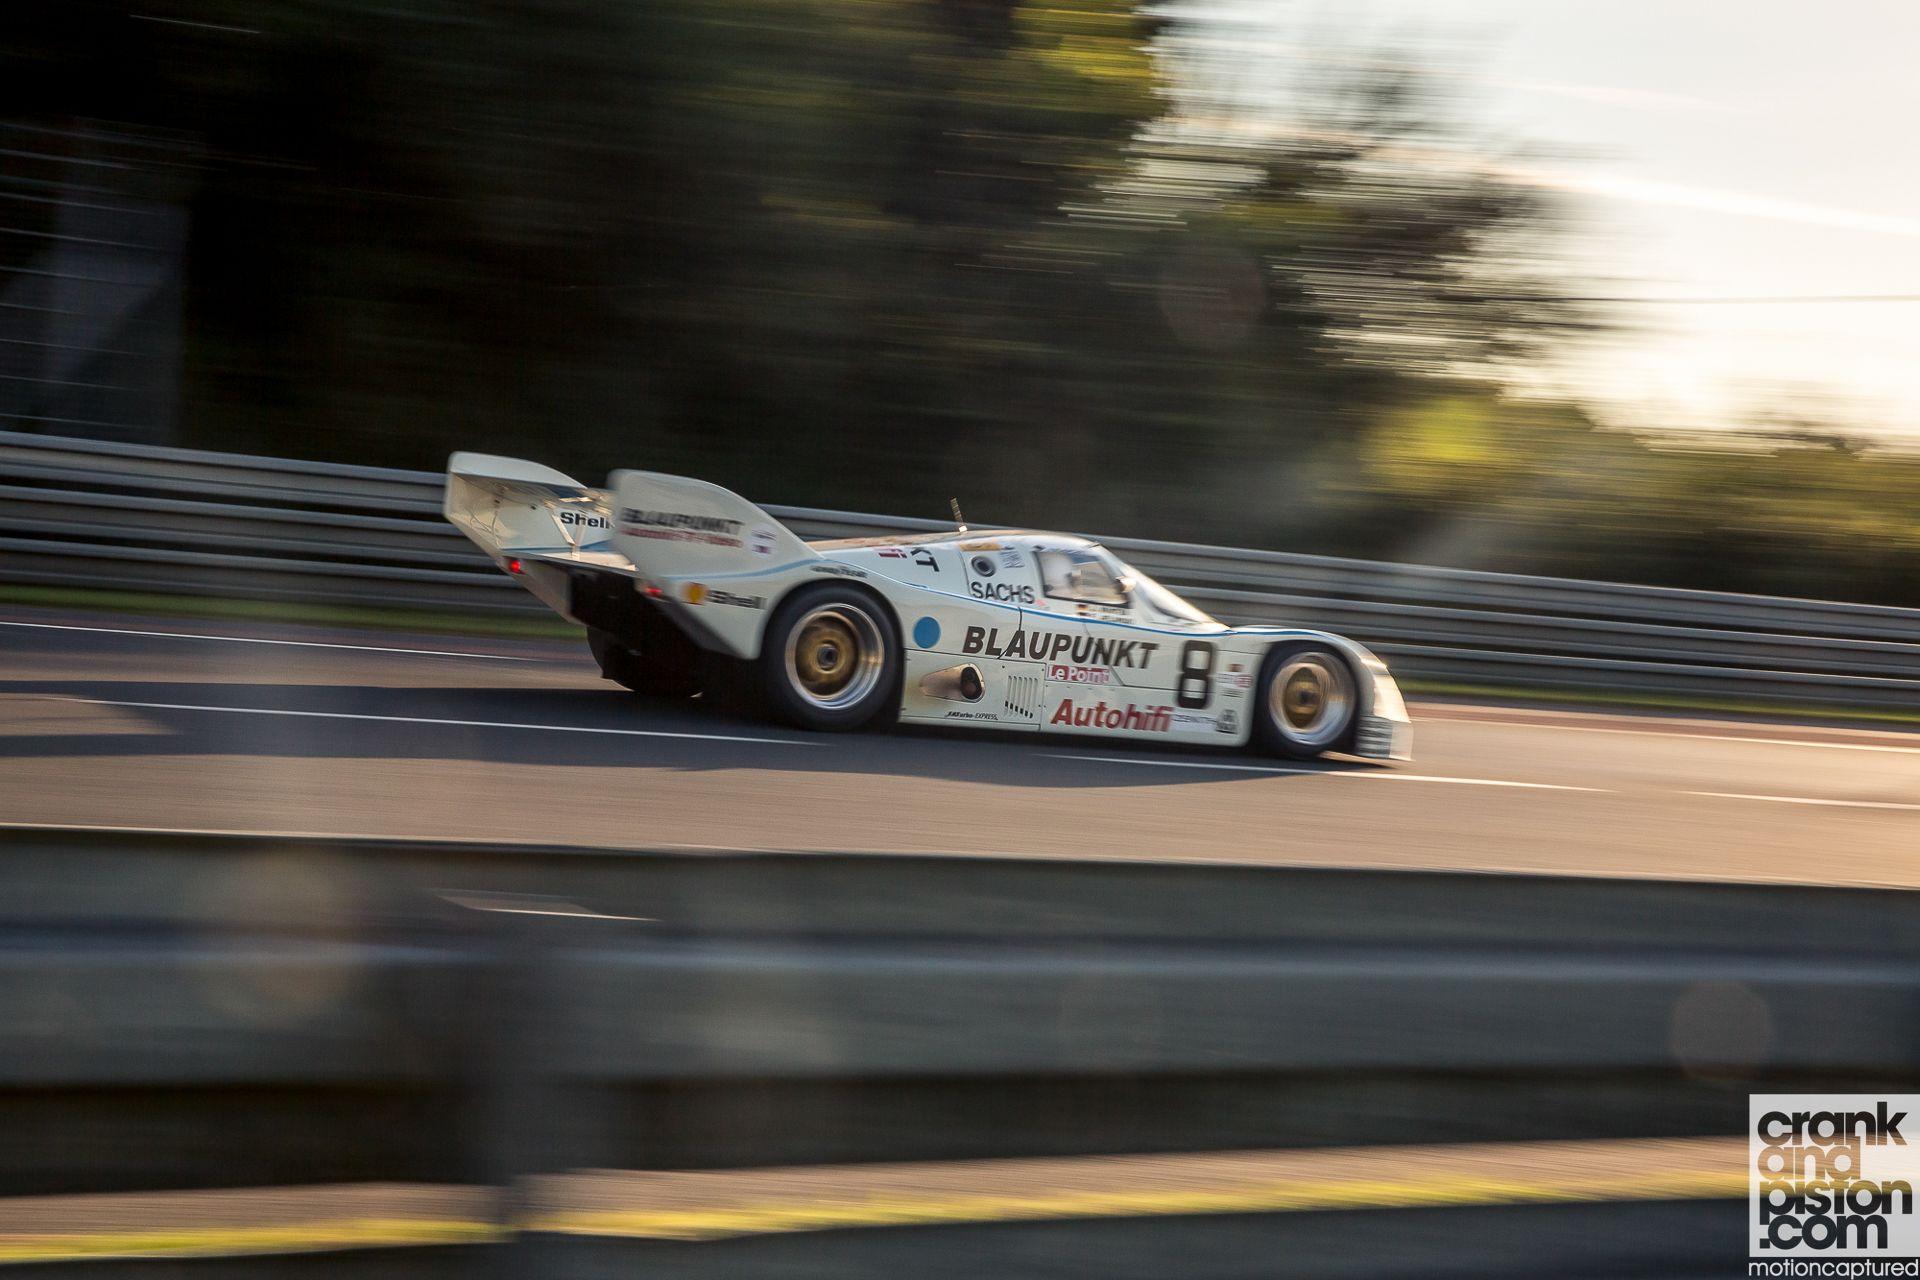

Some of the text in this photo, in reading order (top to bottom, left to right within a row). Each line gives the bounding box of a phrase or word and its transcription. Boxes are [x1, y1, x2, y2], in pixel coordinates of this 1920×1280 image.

[560, 511, 611, 529] Shell
[971, 581, 1036, 604] SACHS
[962, 626, 1159, 669] BLAUPUNKT
[1176, 640, 1217, 709] 8
[1051, 699, 1175, 733] Autohifi
